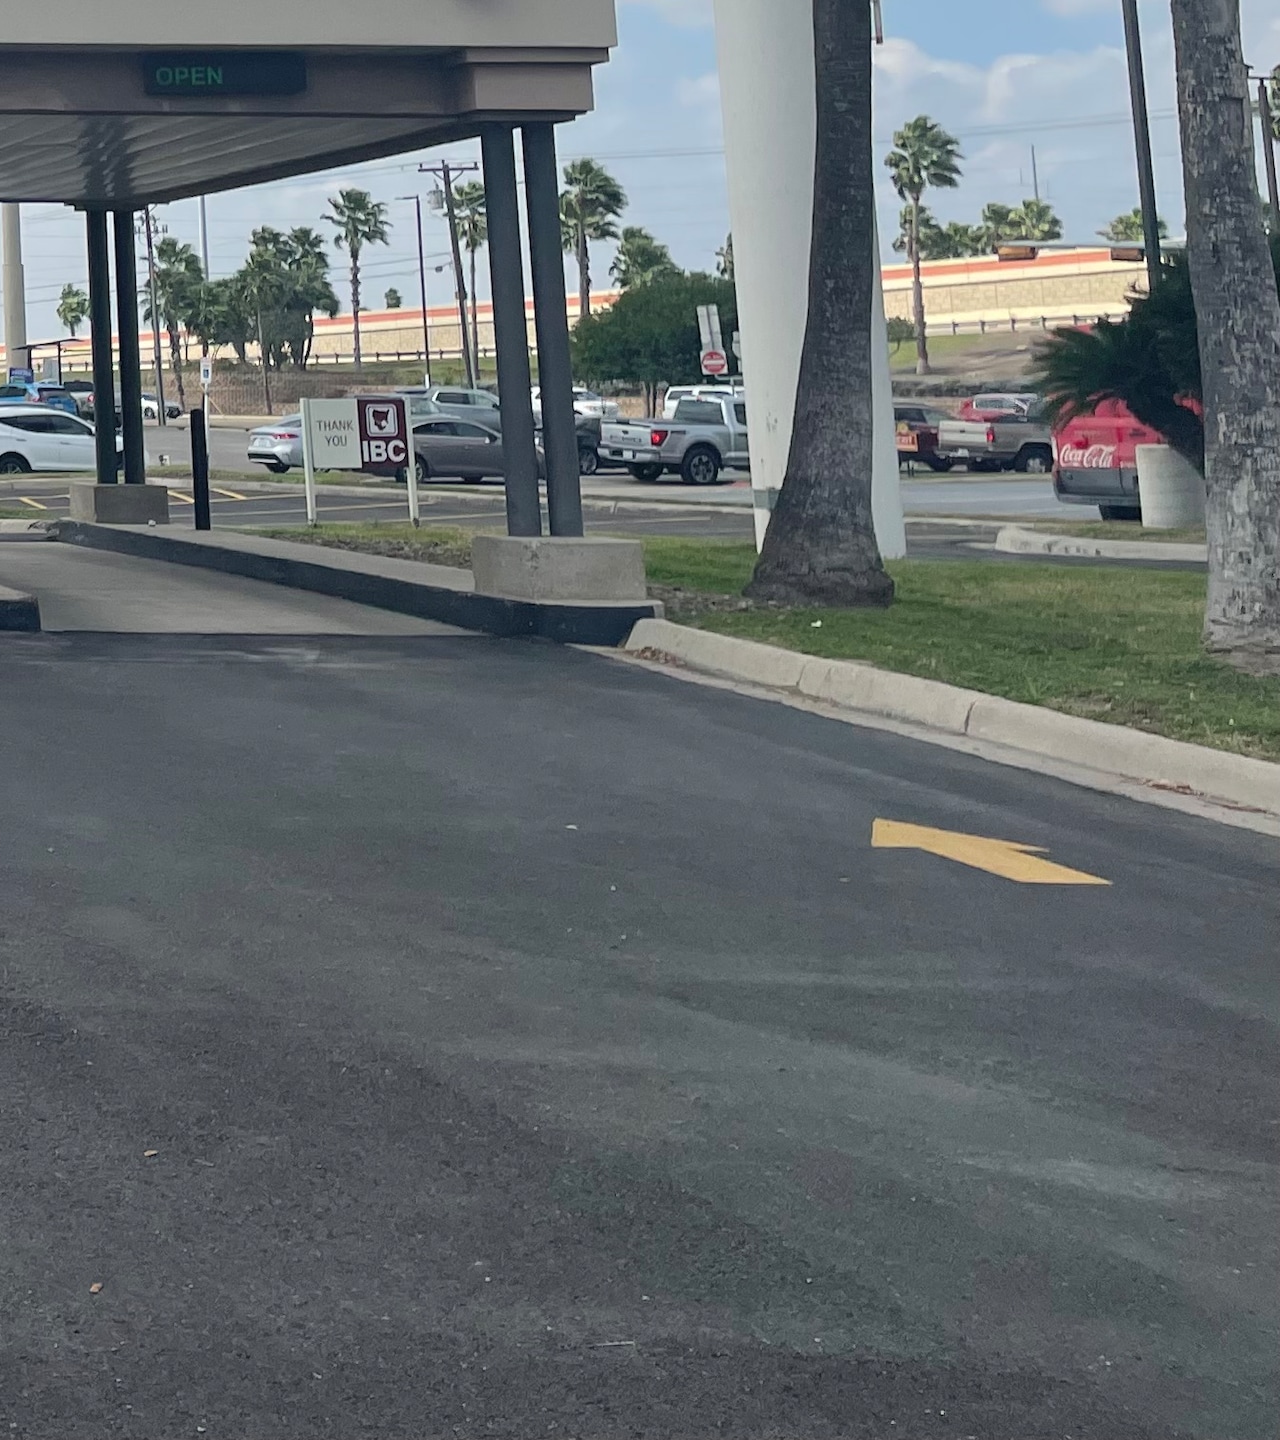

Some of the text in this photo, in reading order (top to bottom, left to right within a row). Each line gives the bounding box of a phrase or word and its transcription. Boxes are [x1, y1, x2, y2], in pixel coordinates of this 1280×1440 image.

[155, 66, 224, 86] OPEN
[317, 420, 354, 432] THANK
[325, 435, 347, 447] YOU
[362, 439, 407, 462] IBC
